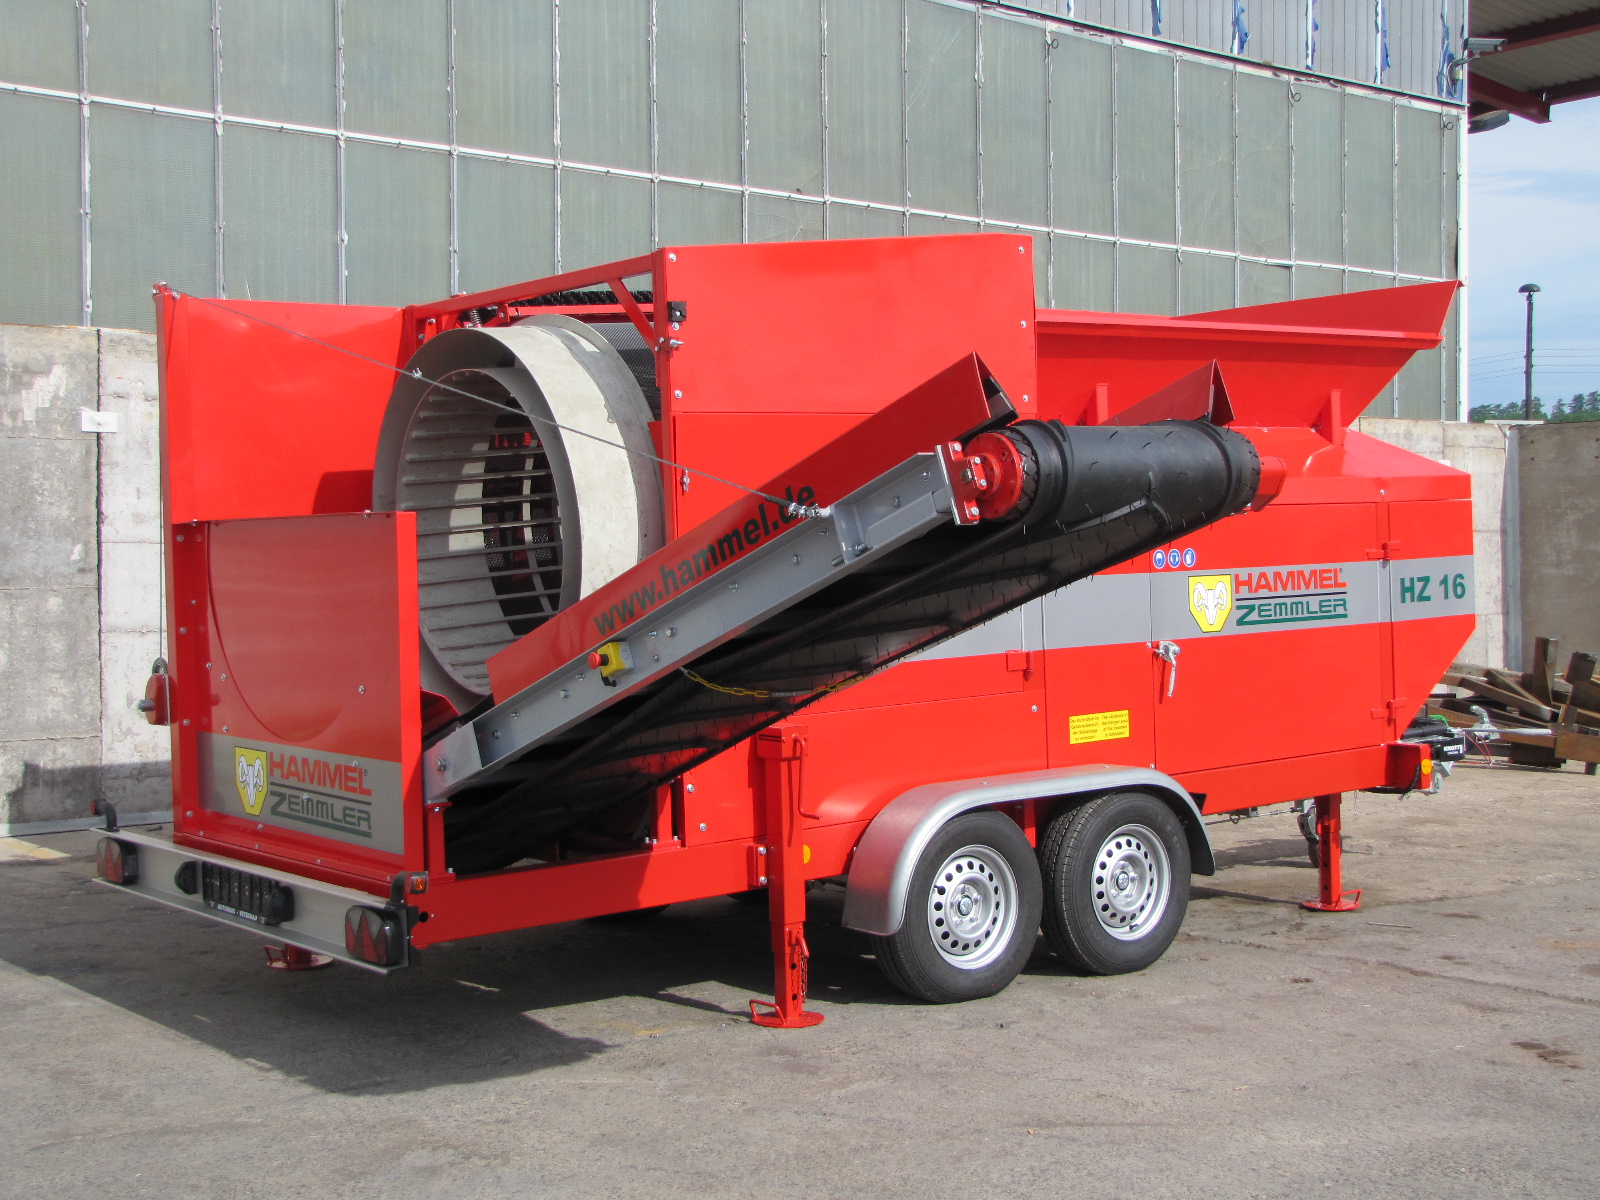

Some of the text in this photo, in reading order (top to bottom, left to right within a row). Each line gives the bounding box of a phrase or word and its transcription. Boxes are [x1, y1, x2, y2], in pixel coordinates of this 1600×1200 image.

[593, 485, 816, 636] www.hammel.de
[1234, 568, 1347, 594] HAMMEL
[1400, 573, 1466, 603] HZ 16
[1235, 598, 1348, 627] ZEMMLER
[270, 752, 372, 797] HAMMEL
[270, 789, 372, 839] ZEMMLER
